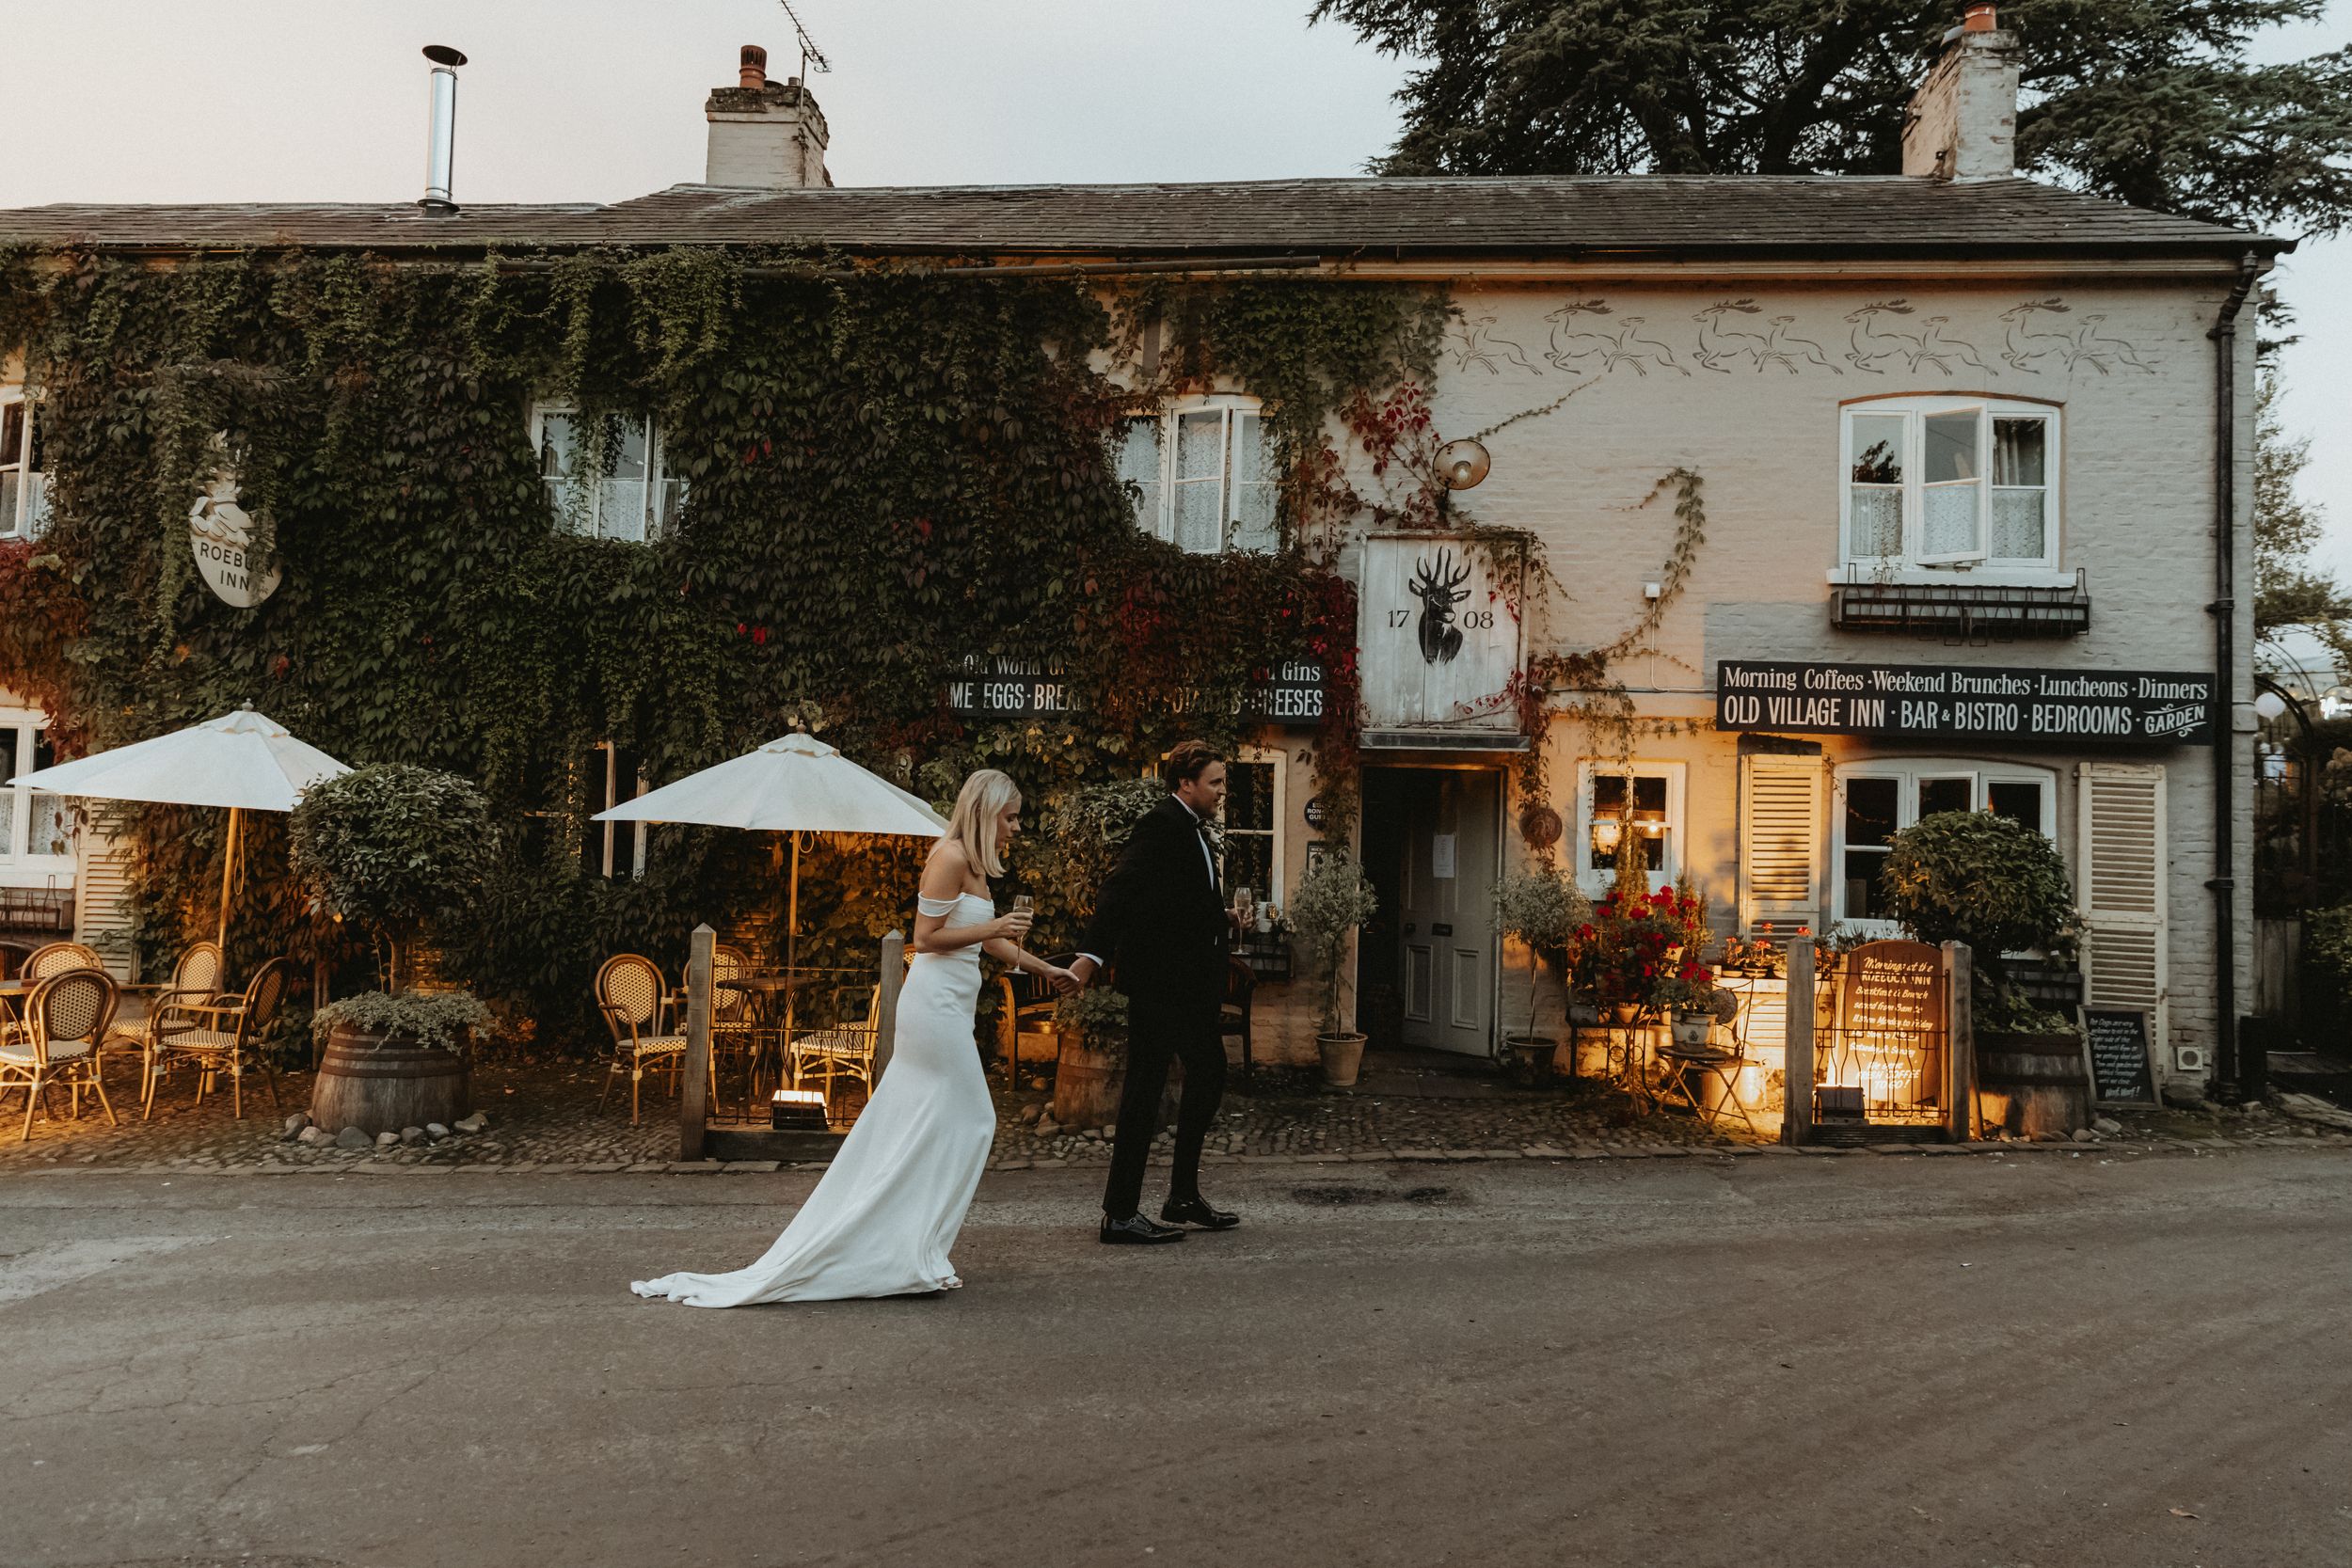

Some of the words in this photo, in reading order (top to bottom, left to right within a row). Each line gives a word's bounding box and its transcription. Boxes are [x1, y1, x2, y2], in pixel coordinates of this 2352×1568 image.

[220, 570, 249, 592] INN
[1387, 610, 1410, 628] 17
[1464, 610, 1494, 629] 08
[996, 656, 1041, 675] World
[1282, 661, 1321, 682] Gins
[1724, 666, 1797, 691] Morning
[1804, 668, 1865, 690] Coffees
[1872, 670, 1946, 693] Weekend
[1951, 672, 2031, 695] Brunches
[2040, 674, 2129, 698] Luncheons
[2137, 677, 2208, 700] Dinners
[983, 683, 1025, 710] EGGS
[1724, 695, 1760, 724] OLD
[1768, 696, 1842, 726] VILLAGE
[1850, 699, 1885, 728] INN
[1900, 700, 1937, 729] BAR
[1941, 708, 1951, 722] &
[1955, 702, 2019, 732] BISTRO
[2031, 704, 2132, 735] BEDROOMS
[2144, 705, 2205, 734] GARDEN
[1864, 957, 1906, 973] Mornings
[1861, 971, 1907, 984] ROEBUCK
[1855, 986, 1893, 997] Breakfast
[1901, 989, 1929, 999] Brunch
